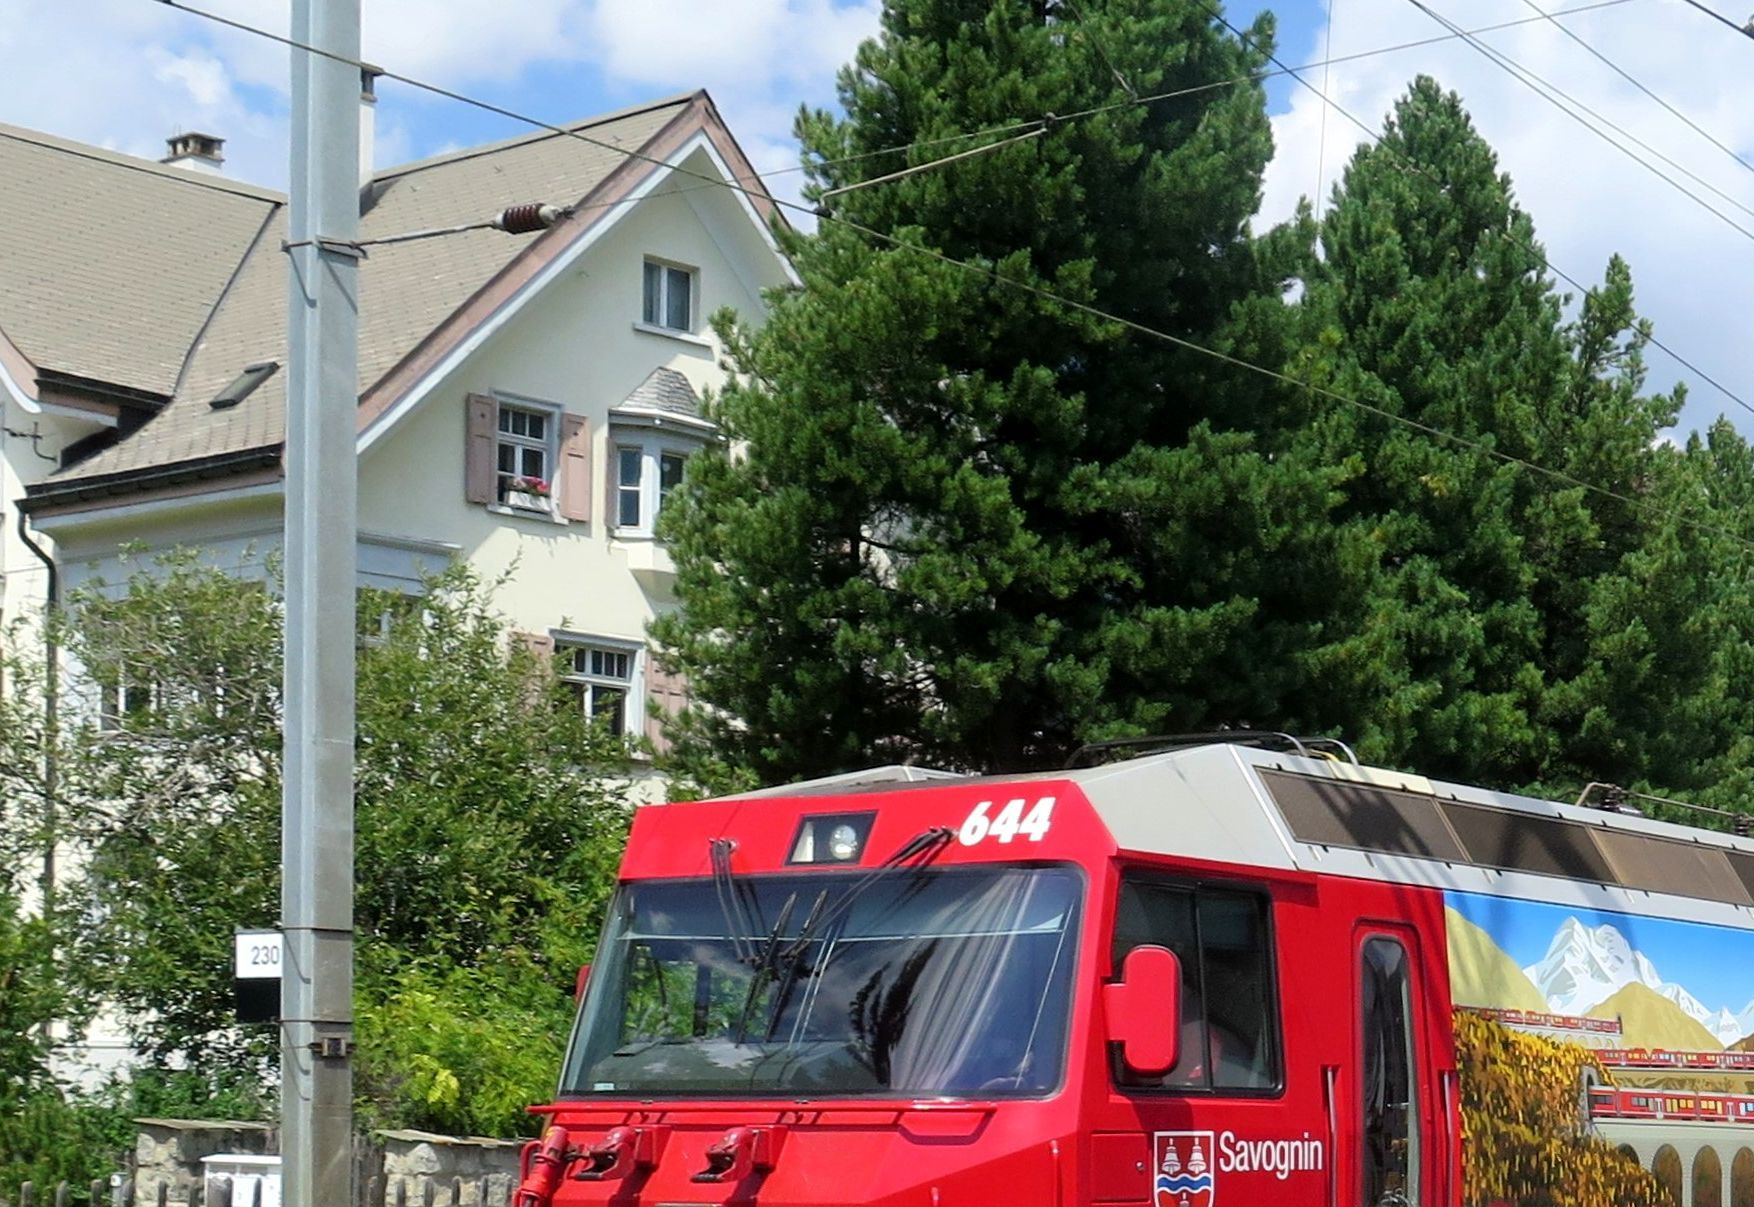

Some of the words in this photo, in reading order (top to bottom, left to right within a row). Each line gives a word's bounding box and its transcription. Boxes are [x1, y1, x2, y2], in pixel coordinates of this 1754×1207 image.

[959, 796, 1057, 846] 644
[251, 945, 280, 965] 230
[1219, 1131, 1323, 1180] Savognin
